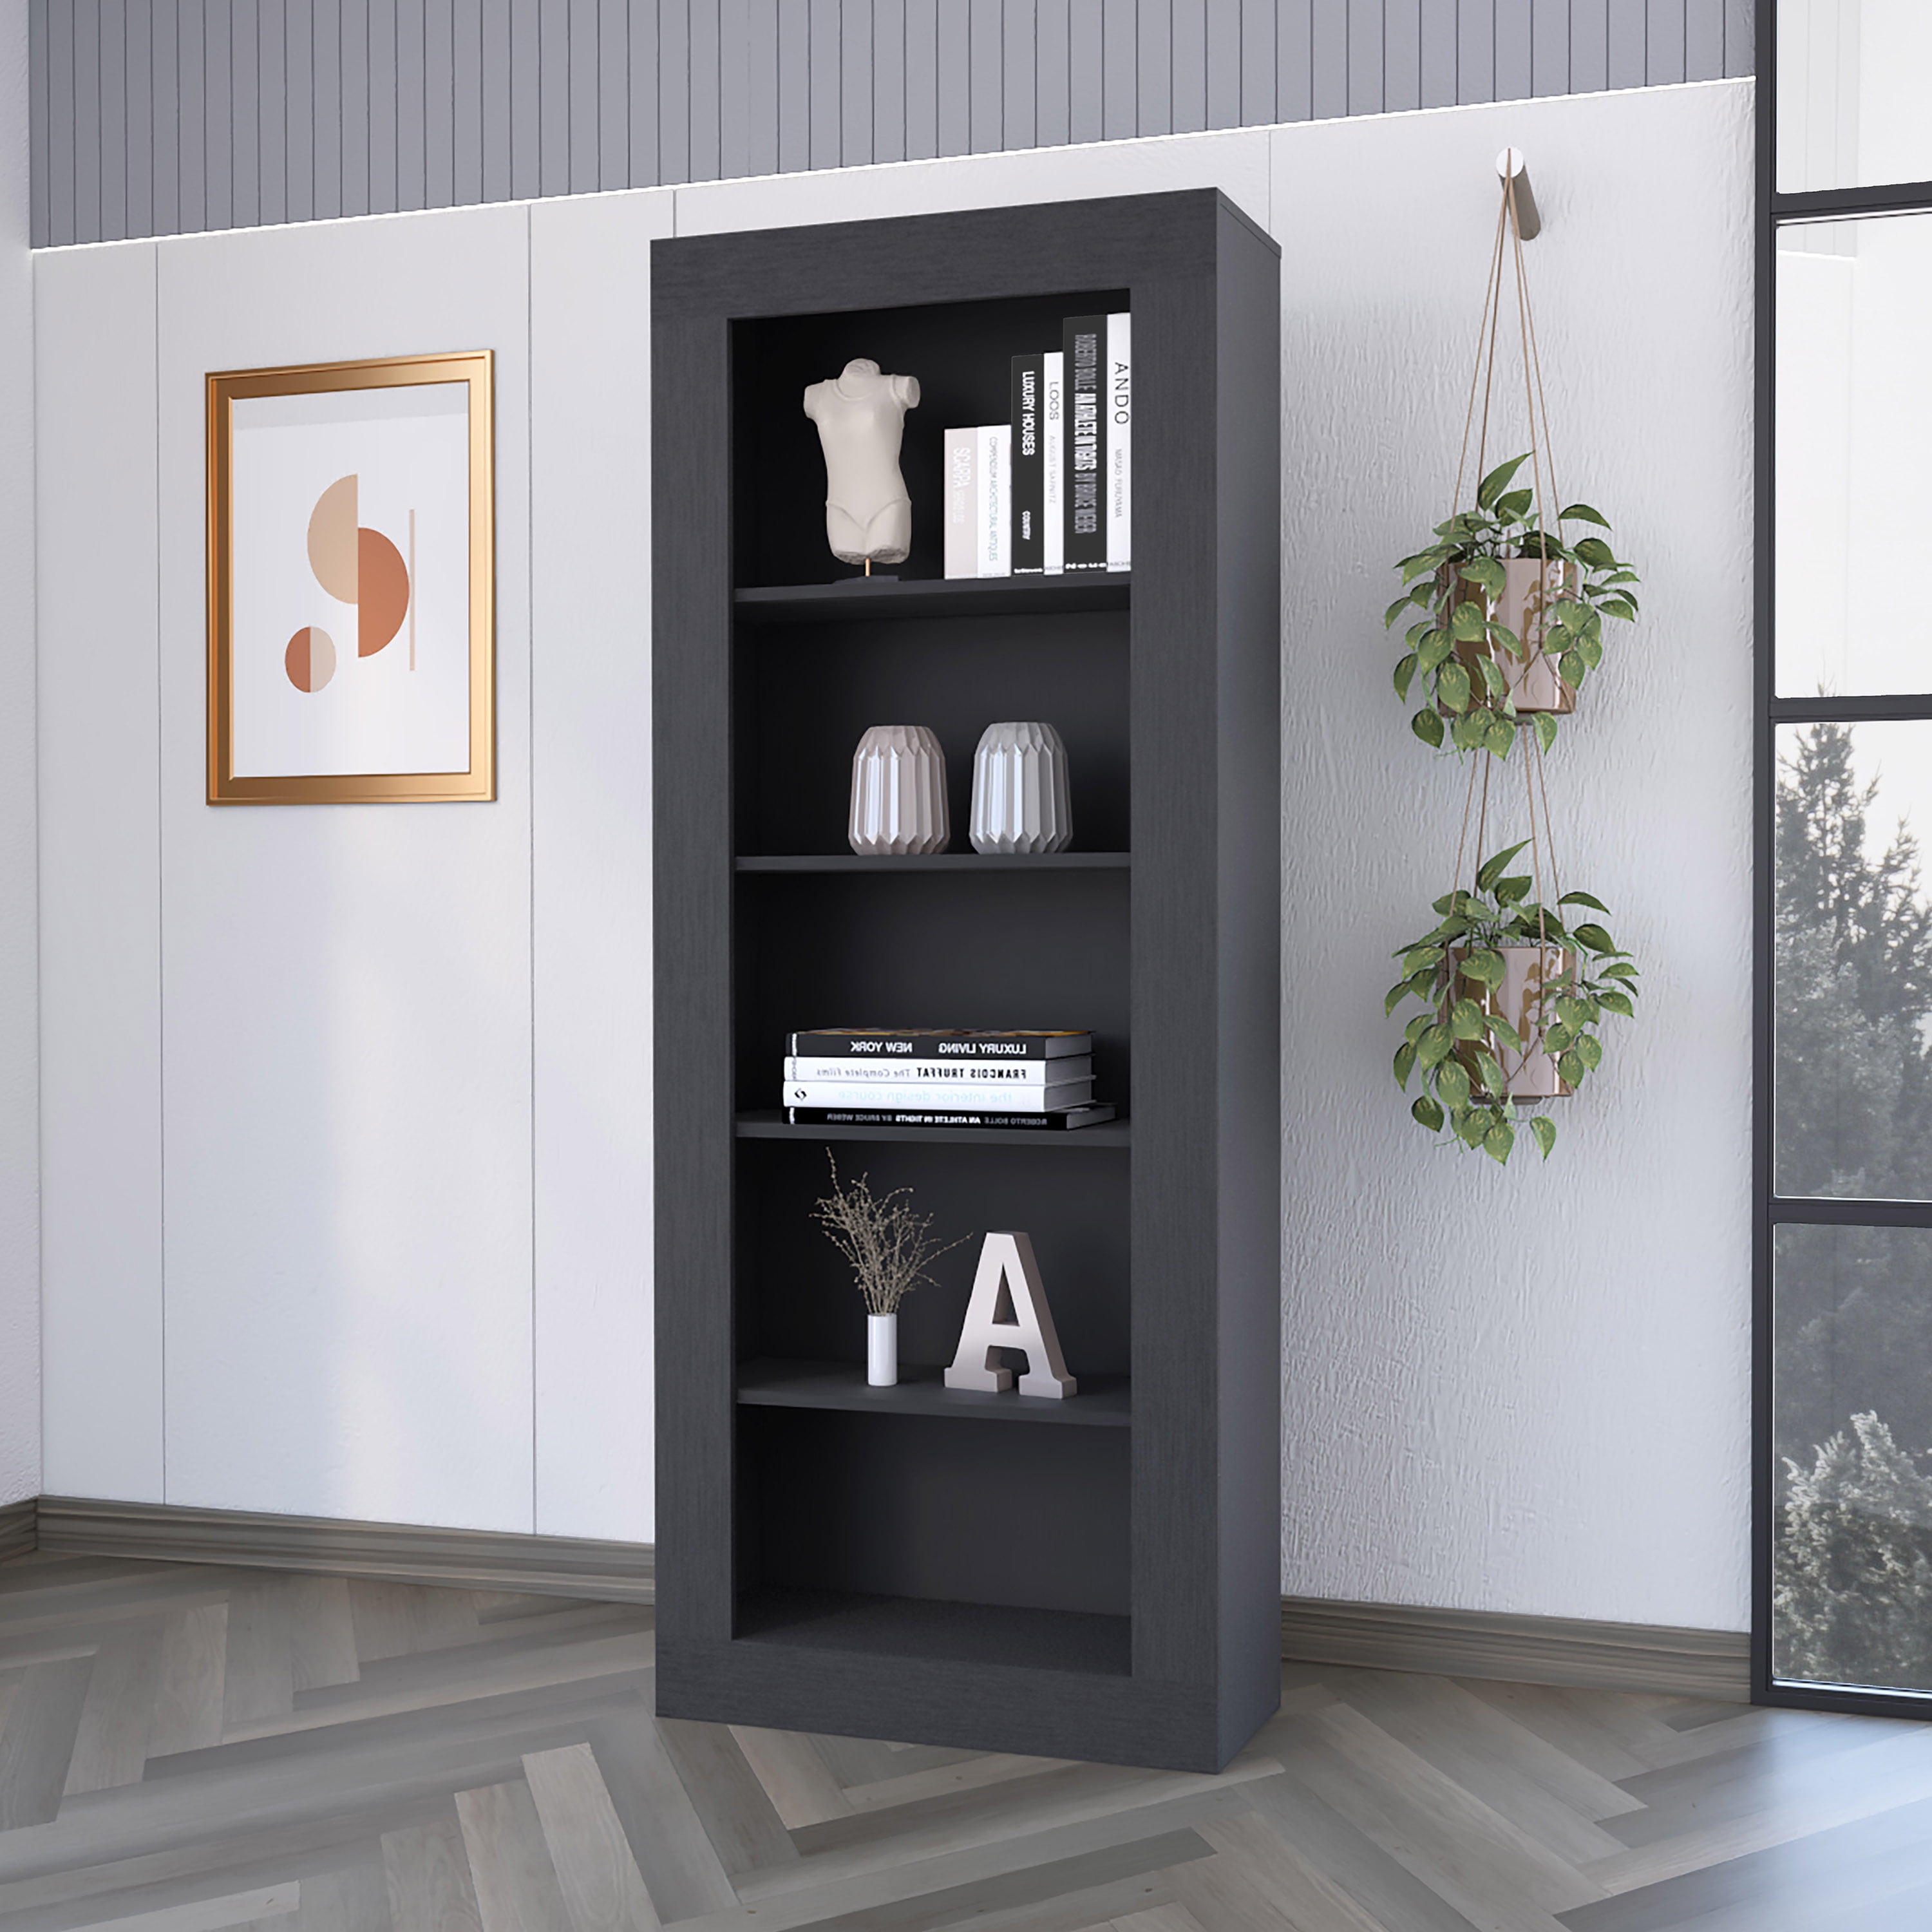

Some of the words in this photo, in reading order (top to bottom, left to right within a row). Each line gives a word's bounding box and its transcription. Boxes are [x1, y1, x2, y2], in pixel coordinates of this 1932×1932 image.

[1022, 371, 1035, 412] LUXURY
[1049, 381, 1059, 421] LOOS
[1115, 362, 1129, 424] ANDO
[1022, 413, 1036, 455] HOUSES
[944, 1231, 1077, 1399] A
